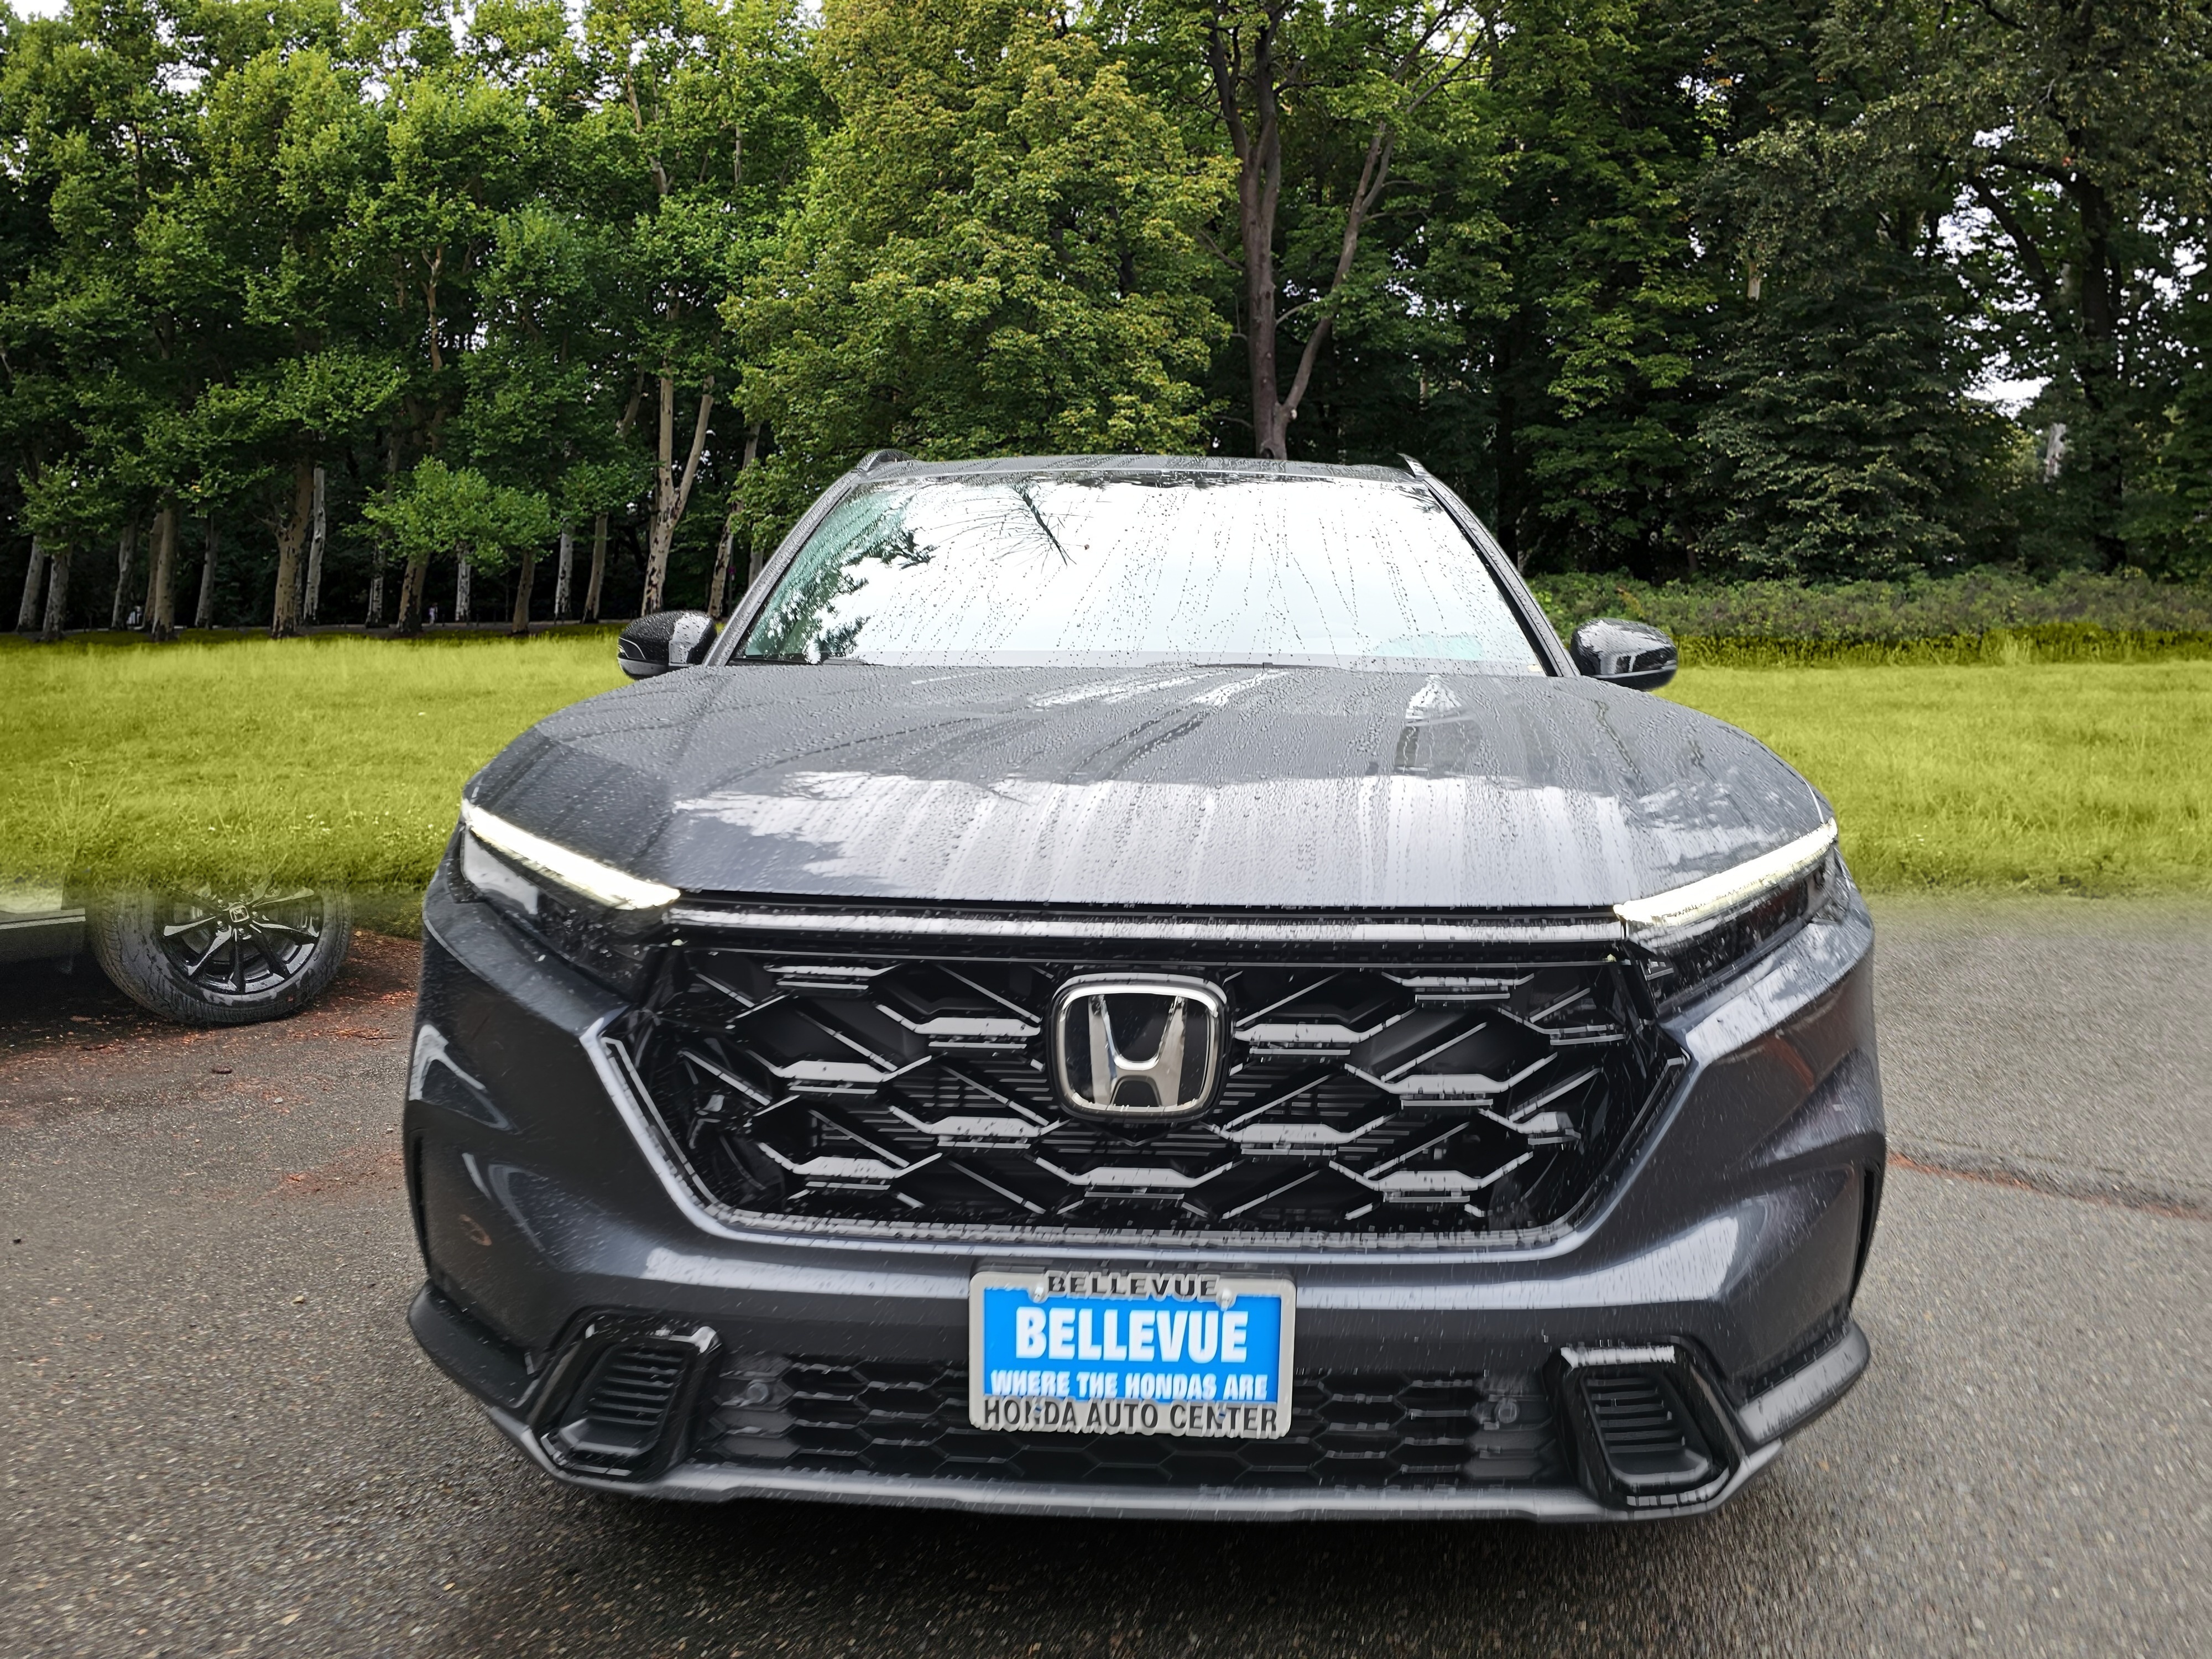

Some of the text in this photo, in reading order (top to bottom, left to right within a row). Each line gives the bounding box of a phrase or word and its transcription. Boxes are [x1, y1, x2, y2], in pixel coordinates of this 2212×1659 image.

[1048, 1275, 1217, 1297] BELLEVUE
[1016, 1306, 1248, 1364] BELLEVUE
[990, 1369, 1268, 1400] WHERE THE HONDAS ARE
[984, 1400, 1277, 1432] HONDA AUTO CENTER
